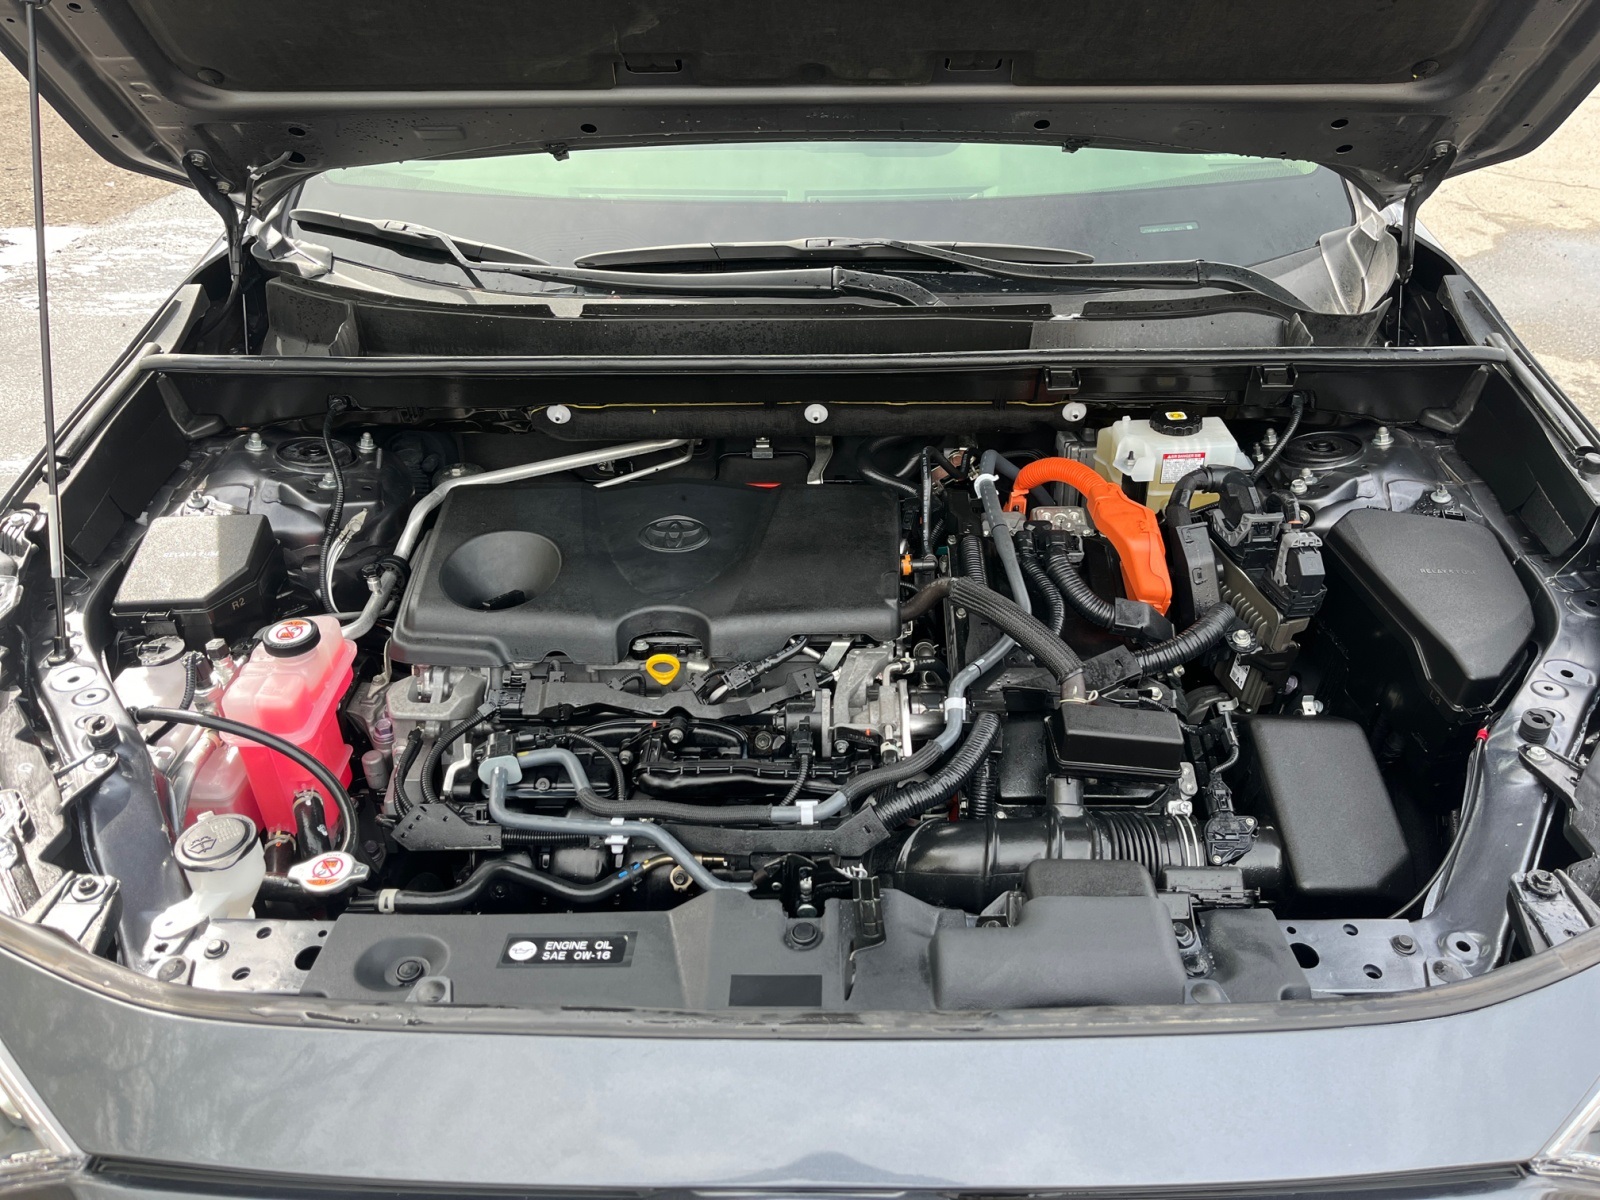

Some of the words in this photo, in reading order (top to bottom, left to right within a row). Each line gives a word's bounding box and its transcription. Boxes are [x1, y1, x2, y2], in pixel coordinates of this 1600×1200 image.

[231, 597, 246, 611] R2
[544, 940, 588, 950] ENGINE
[594, 940, 613, 950] OIL
[541, 951, 567, 960] SAE
[573, 950, 611, 960] 0W-16
